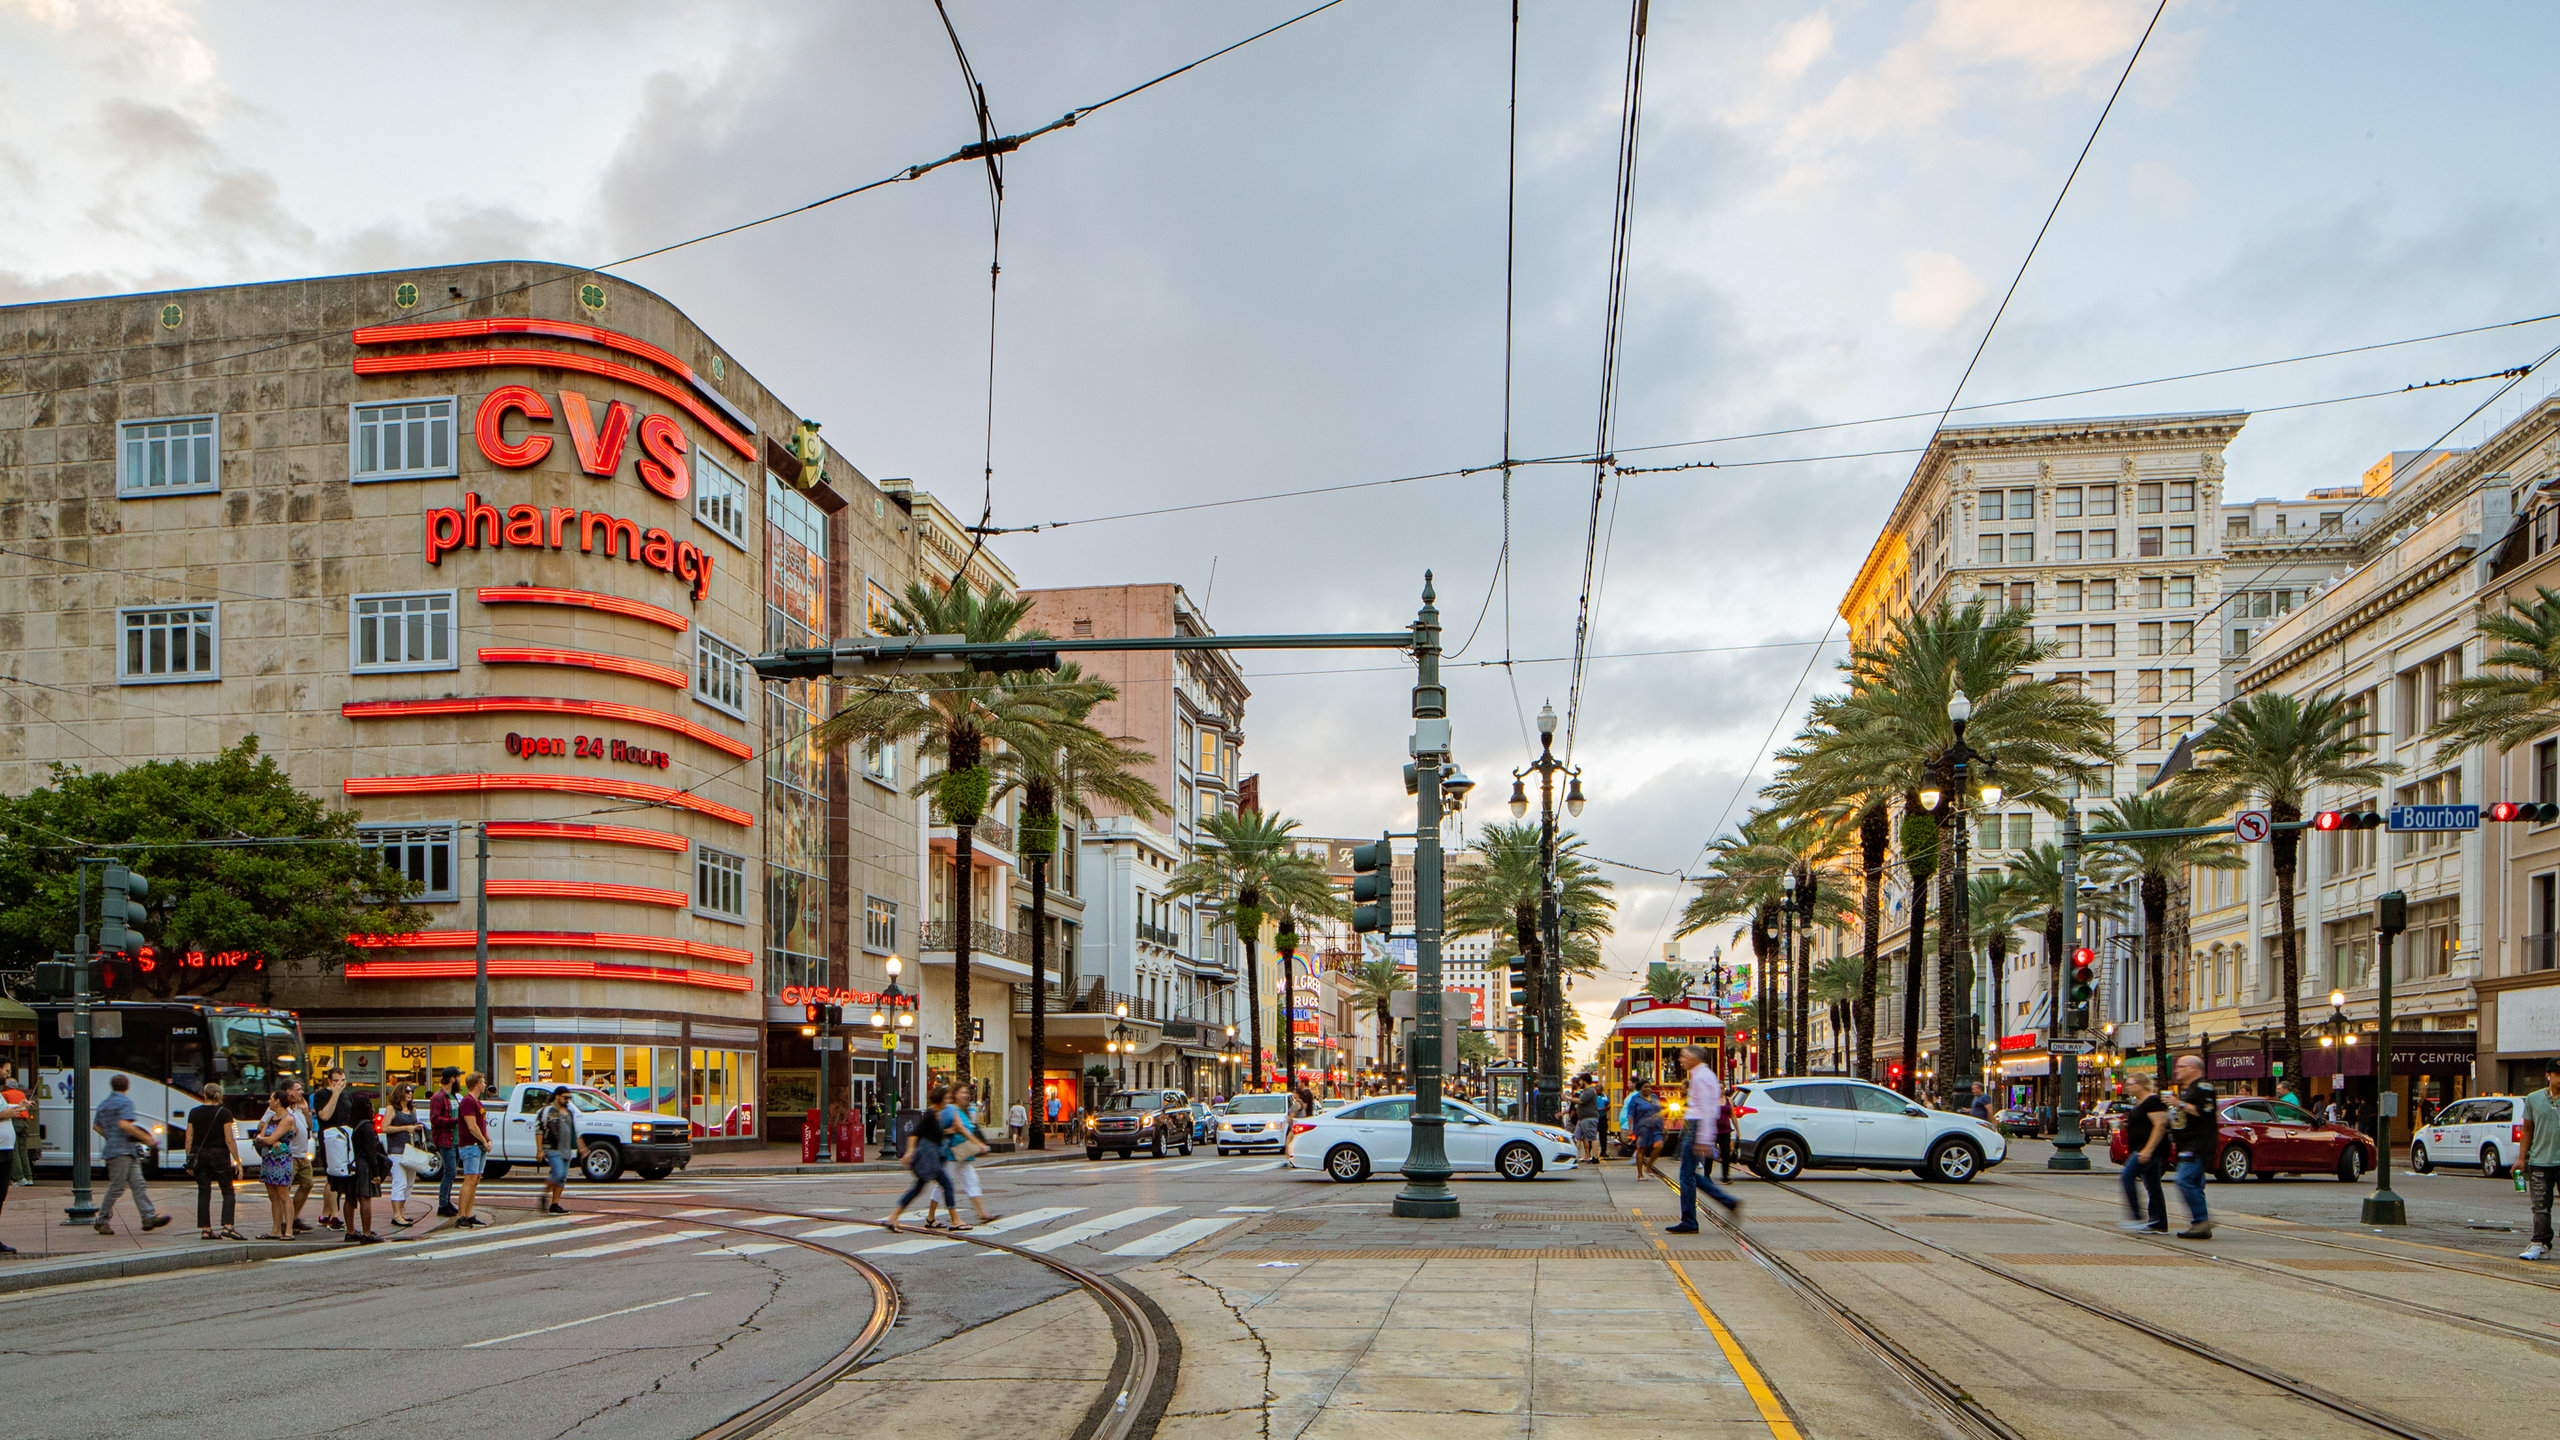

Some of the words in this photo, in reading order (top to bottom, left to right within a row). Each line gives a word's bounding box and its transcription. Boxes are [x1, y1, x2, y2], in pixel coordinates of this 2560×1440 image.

[474, 384, 691, 500] CVS
[426, 492, 714, 601] pharmacy
[505, 732, 566, 760] Open
[574, 735, 604, 758] 24
[611, 739, 670, 769] Hours
[2403, 806, 2475, 828] Bourbon
[1294, 996, 1319, 1007] RUGS
[886, 1037, 893, 1046] K
[2216, 1056, 2231, 1068] HYATT
[2232, 1055, 2255, 1068] CENTRIC
[2419, 1053, 2475, 1064] CENTRIC
